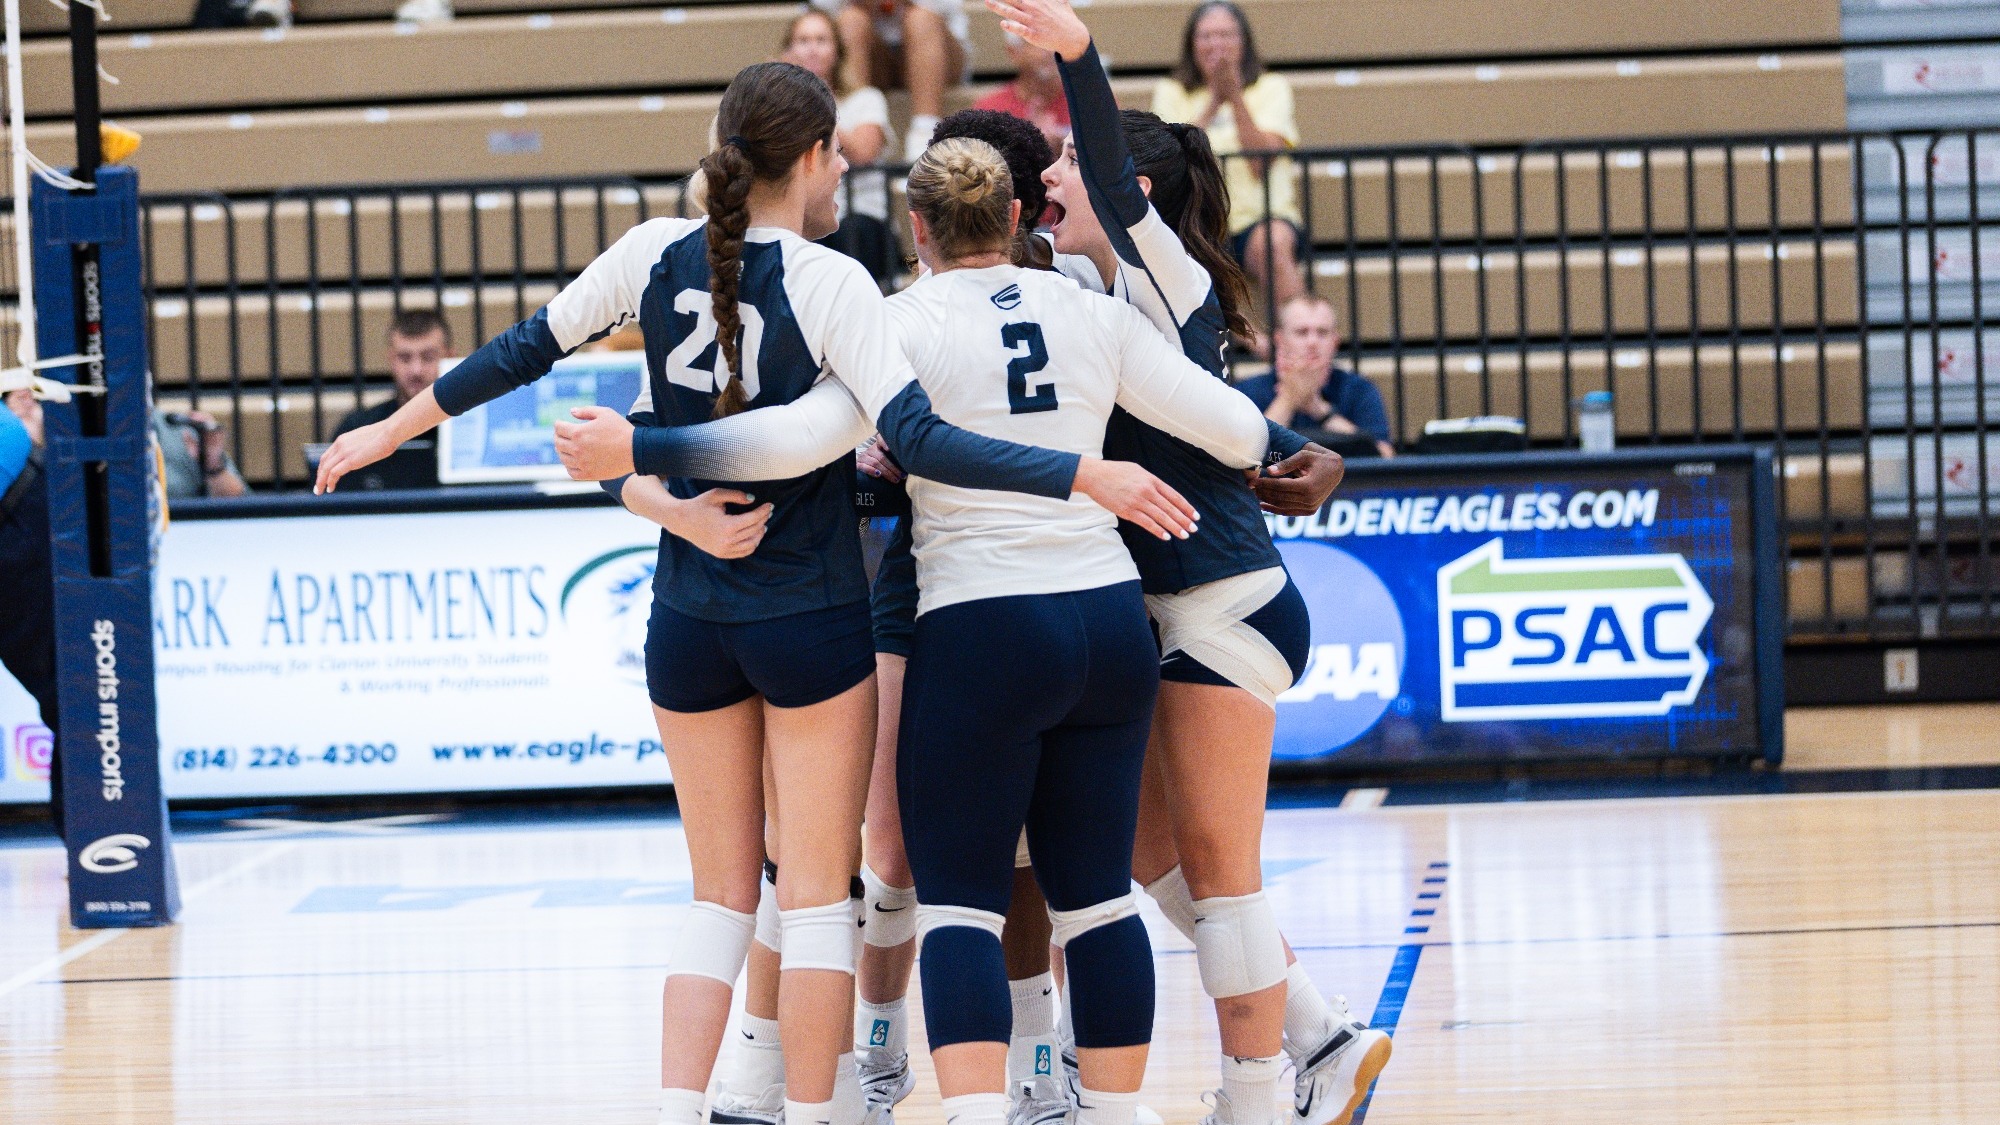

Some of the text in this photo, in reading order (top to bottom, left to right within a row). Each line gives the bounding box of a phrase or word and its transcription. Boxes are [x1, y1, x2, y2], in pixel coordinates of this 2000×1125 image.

[665, 287, 765, 402] 20
[1001, 321, 1059, 415] 2
[1263, 489, 1660, 540] OLDENEAGLES.COM
[260, 565, 550, 647] APARTMENTS
[1452, 603, 1690, 668] PSAC
[1276, 642, 1400, 704] AA
[90, 619, 126, 802] sports imports
[173, 742, 398, 772] (814) 226-4300
